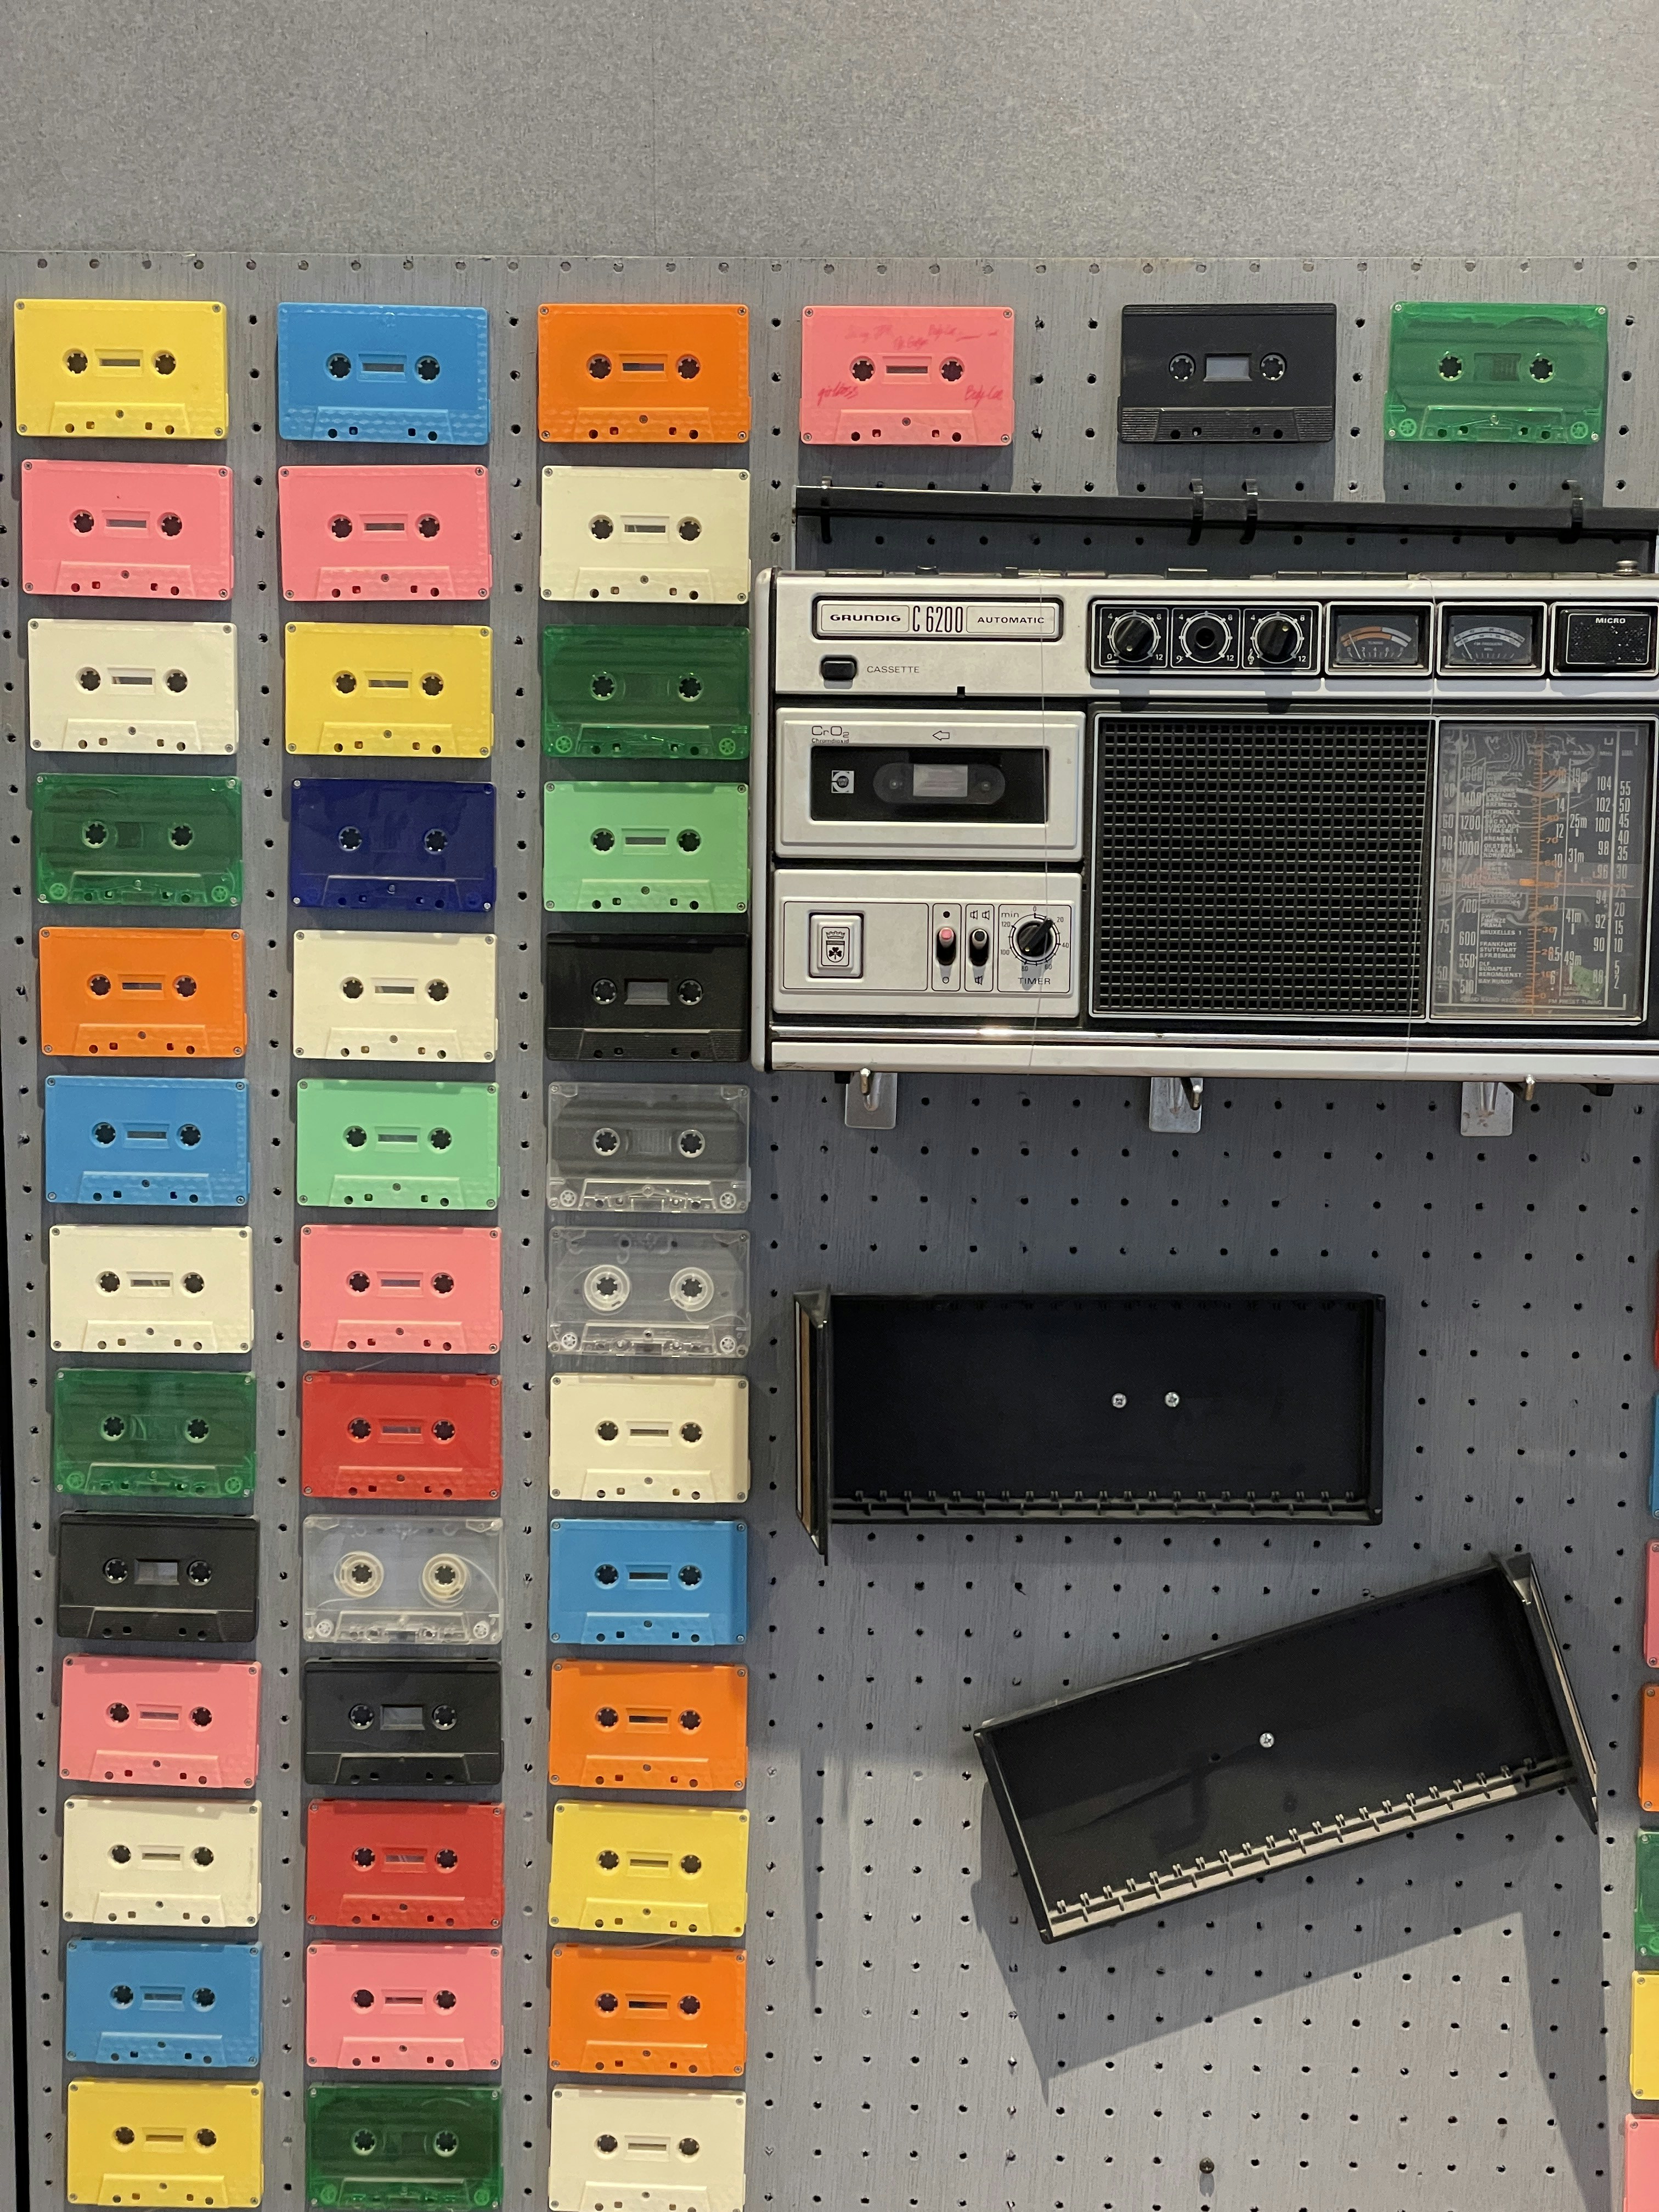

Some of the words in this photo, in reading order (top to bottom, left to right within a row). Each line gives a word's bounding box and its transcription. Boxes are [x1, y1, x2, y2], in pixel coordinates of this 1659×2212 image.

[830, 613, 901, 622] GRUNDIG
[912, 606, 921, 632] C
[926, 606, 963, 633] 6200
[977, 616, 1045, 624] AUTOMATIC
[867, 665, 920, 674] CASSETTE
[1597, 776, 1612, 791] 104
[1620, 781, 1630, 795] 55
[1557, 798, 1565, 812] 14
[1596, 797, 1611, 812] 102
[1619, 797, 1630, 812] 50
[1461, 815, 1481, 830] 1200
[1570, 814, 1587, 828] 25m
[1595, 817, 1610, 832] 100
[1619, 813, 1629, 828] 45
[1556, 823, 1564, 838] 12
[1618, 830, 1629, 845] 40
[1459, 840, 1480, 855] 1000
[1598, 840, 1609, 855] 98
[1617, 846, 1628, 861] 35
[1554, 854, 1562, 868] 10
[1568, 848, 1584, 863] 31m
[1597, 864, 1608, 879] 96
[1616, 864, 1627, 879] 30
[1596, 890, 1607, 904] 94
[1462, 899, 1477, 913] 700
[1614, 902, 1625, 917] 20
[1566, 909, 1581, 923] 41m
[1595, 914, 1606, 929] 92
[1615, 920, 1623, 934] 15
[1459, 931, 1476, 946] 600
[1593, 937, 1605, 952] 90
[1614, 938, 1623, 952] 10
[1459, 953, 1475, 968] 550
[1564, 951, 1582, 966] 49m
[1615, 960, 1620, 974] 5
[1593, 969, 1604, 984] 88
[1614, 975, 1620, 989] 2
[1460, 979, 1474, 994] 510
